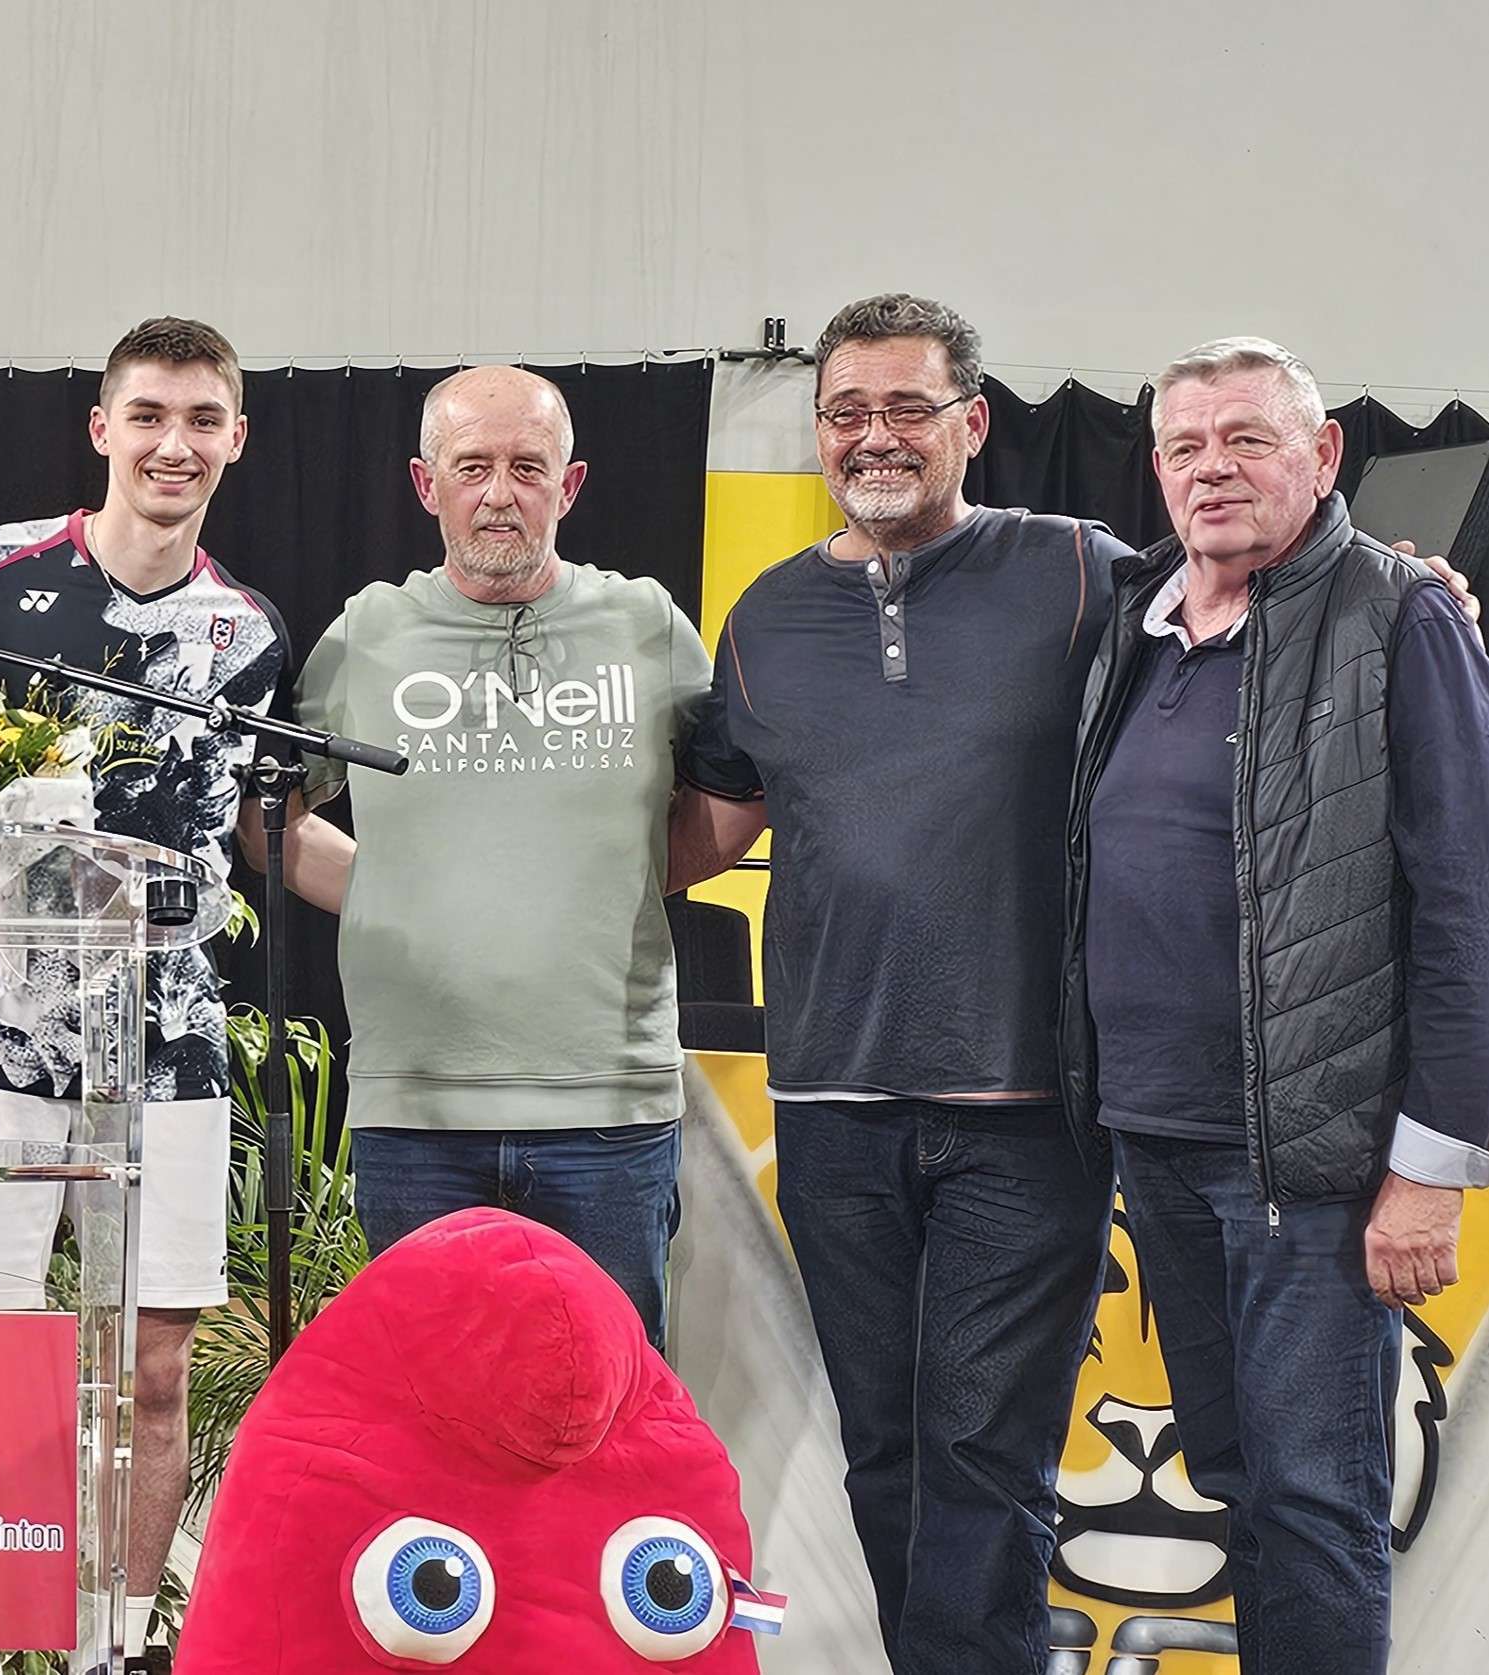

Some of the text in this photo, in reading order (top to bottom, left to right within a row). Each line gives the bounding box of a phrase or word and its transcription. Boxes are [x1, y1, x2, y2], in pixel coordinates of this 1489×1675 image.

[392, 664, 636, 730] O'Neill
[396, 728, 635, 755] SANTA CRUZ
[409, 754, 635, 775] ALIFORNIA-U.S.A
